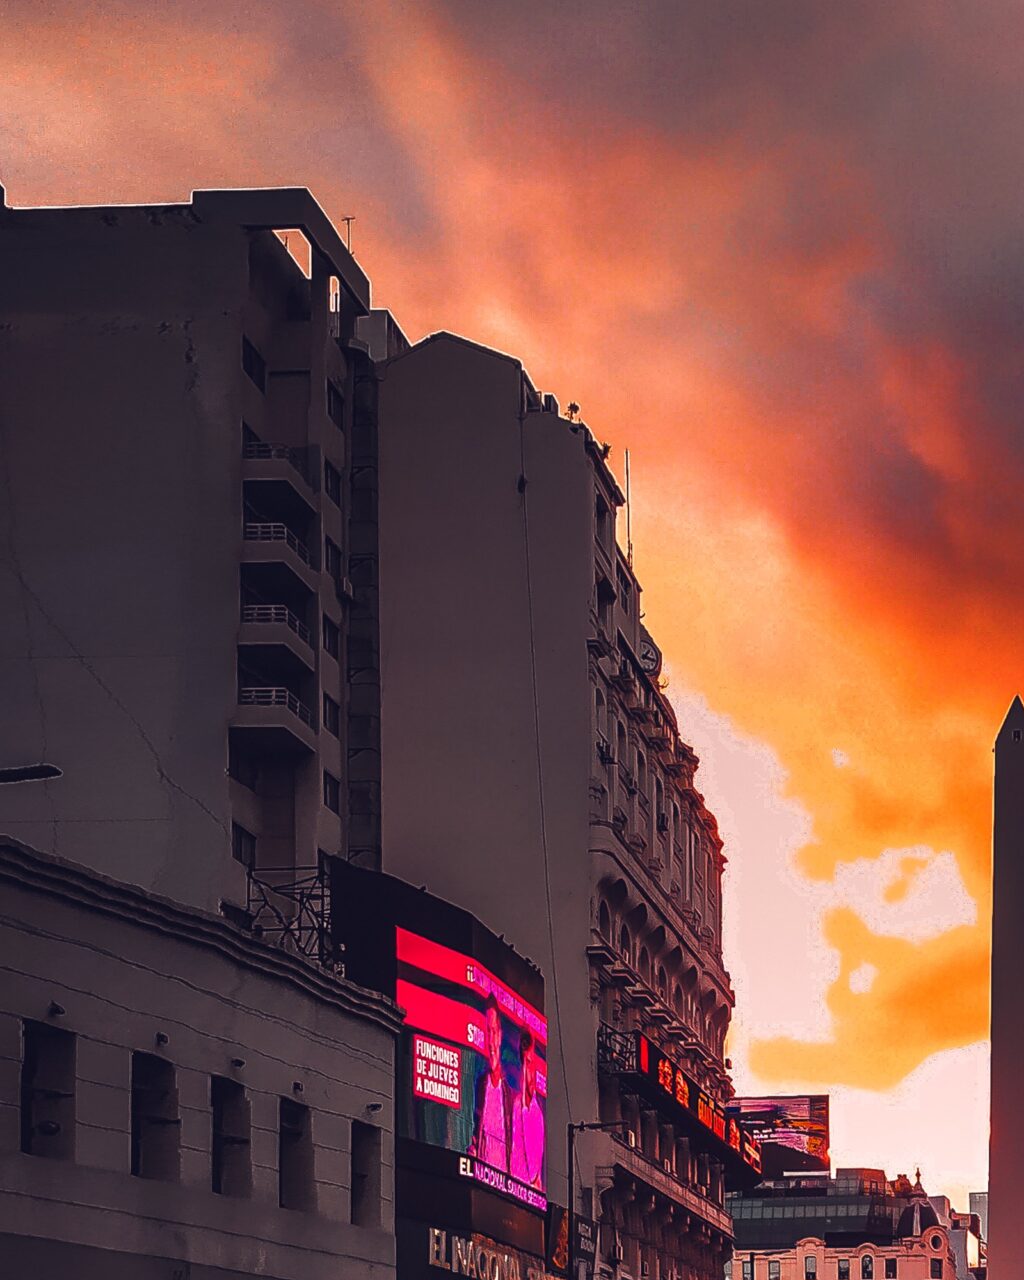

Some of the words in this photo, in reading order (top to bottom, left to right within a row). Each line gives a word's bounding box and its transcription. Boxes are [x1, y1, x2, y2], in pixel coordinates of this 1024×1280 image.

[416, 1039, 459, 1069] FUNCIONES
[416, 1059, 427, 1075] DE
[428, 1063, 459, 1085] JUEVES
[416, 1077, 423, 1091] A
[423, 1080, 459, 1104] DOMINGO
[459, 1157, 474, 1177] EL
[429, 1227, 450, 1270] EL
